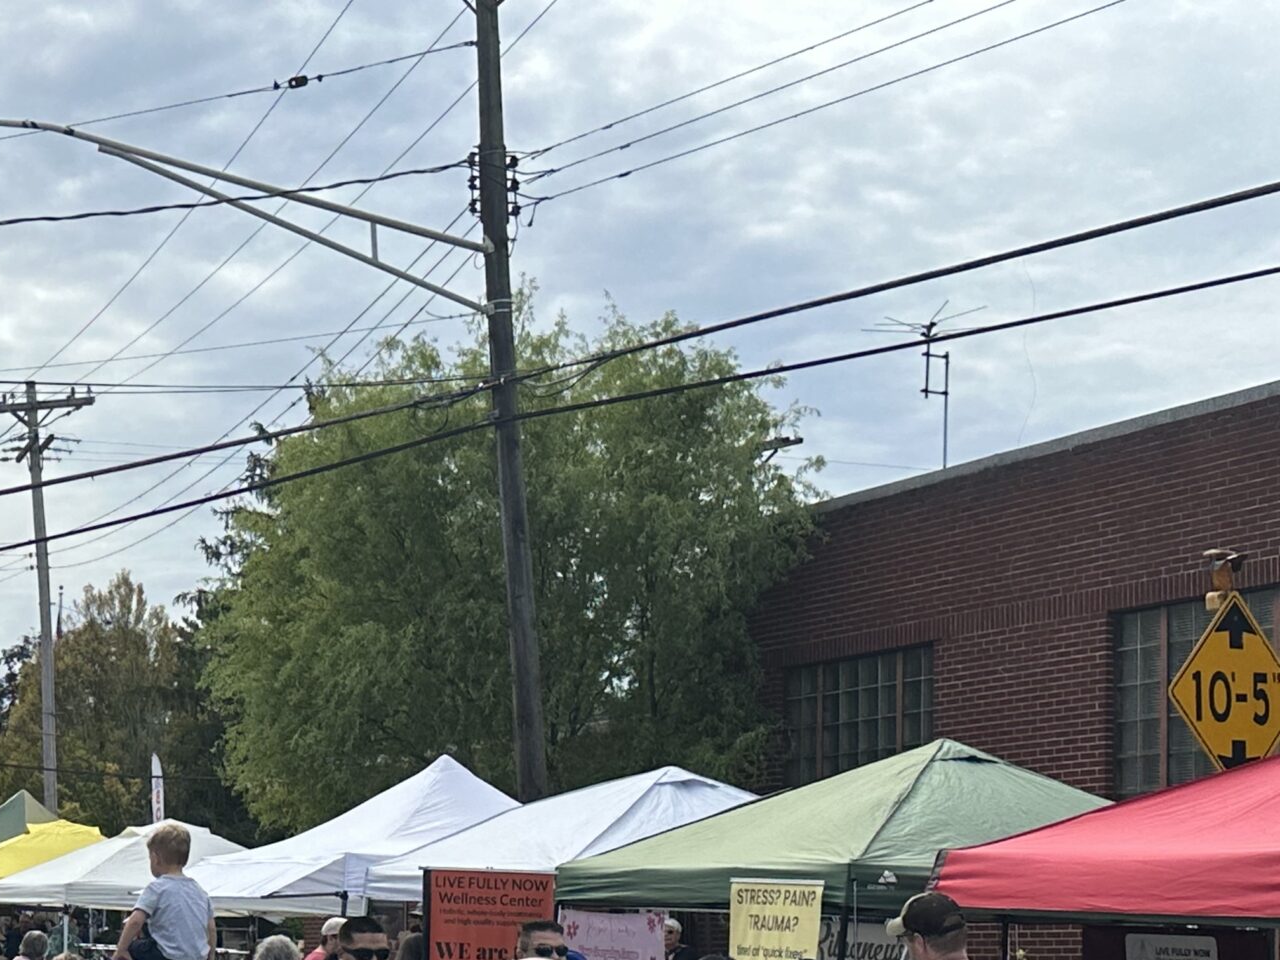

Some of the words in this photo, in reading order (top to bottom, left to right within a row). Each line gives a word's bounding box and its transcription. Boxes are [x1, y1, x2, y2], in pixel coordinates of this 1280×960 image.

[435, 876, 465, 889] LIVE
[468, 877, 509, 890] FULLY
[512, 879, 549, 892] NOW
[439, 891, 497, 905] Wellness
[500, 894, 544, 907] Center
[736, 888, 781, 905] STRESS?
[783, 890, 816, 907] PAIN?
[748, 914, 799, 933] TRAUMA?
[435, 942, 471, 960] WE
[476, 946, 508, 960] are
